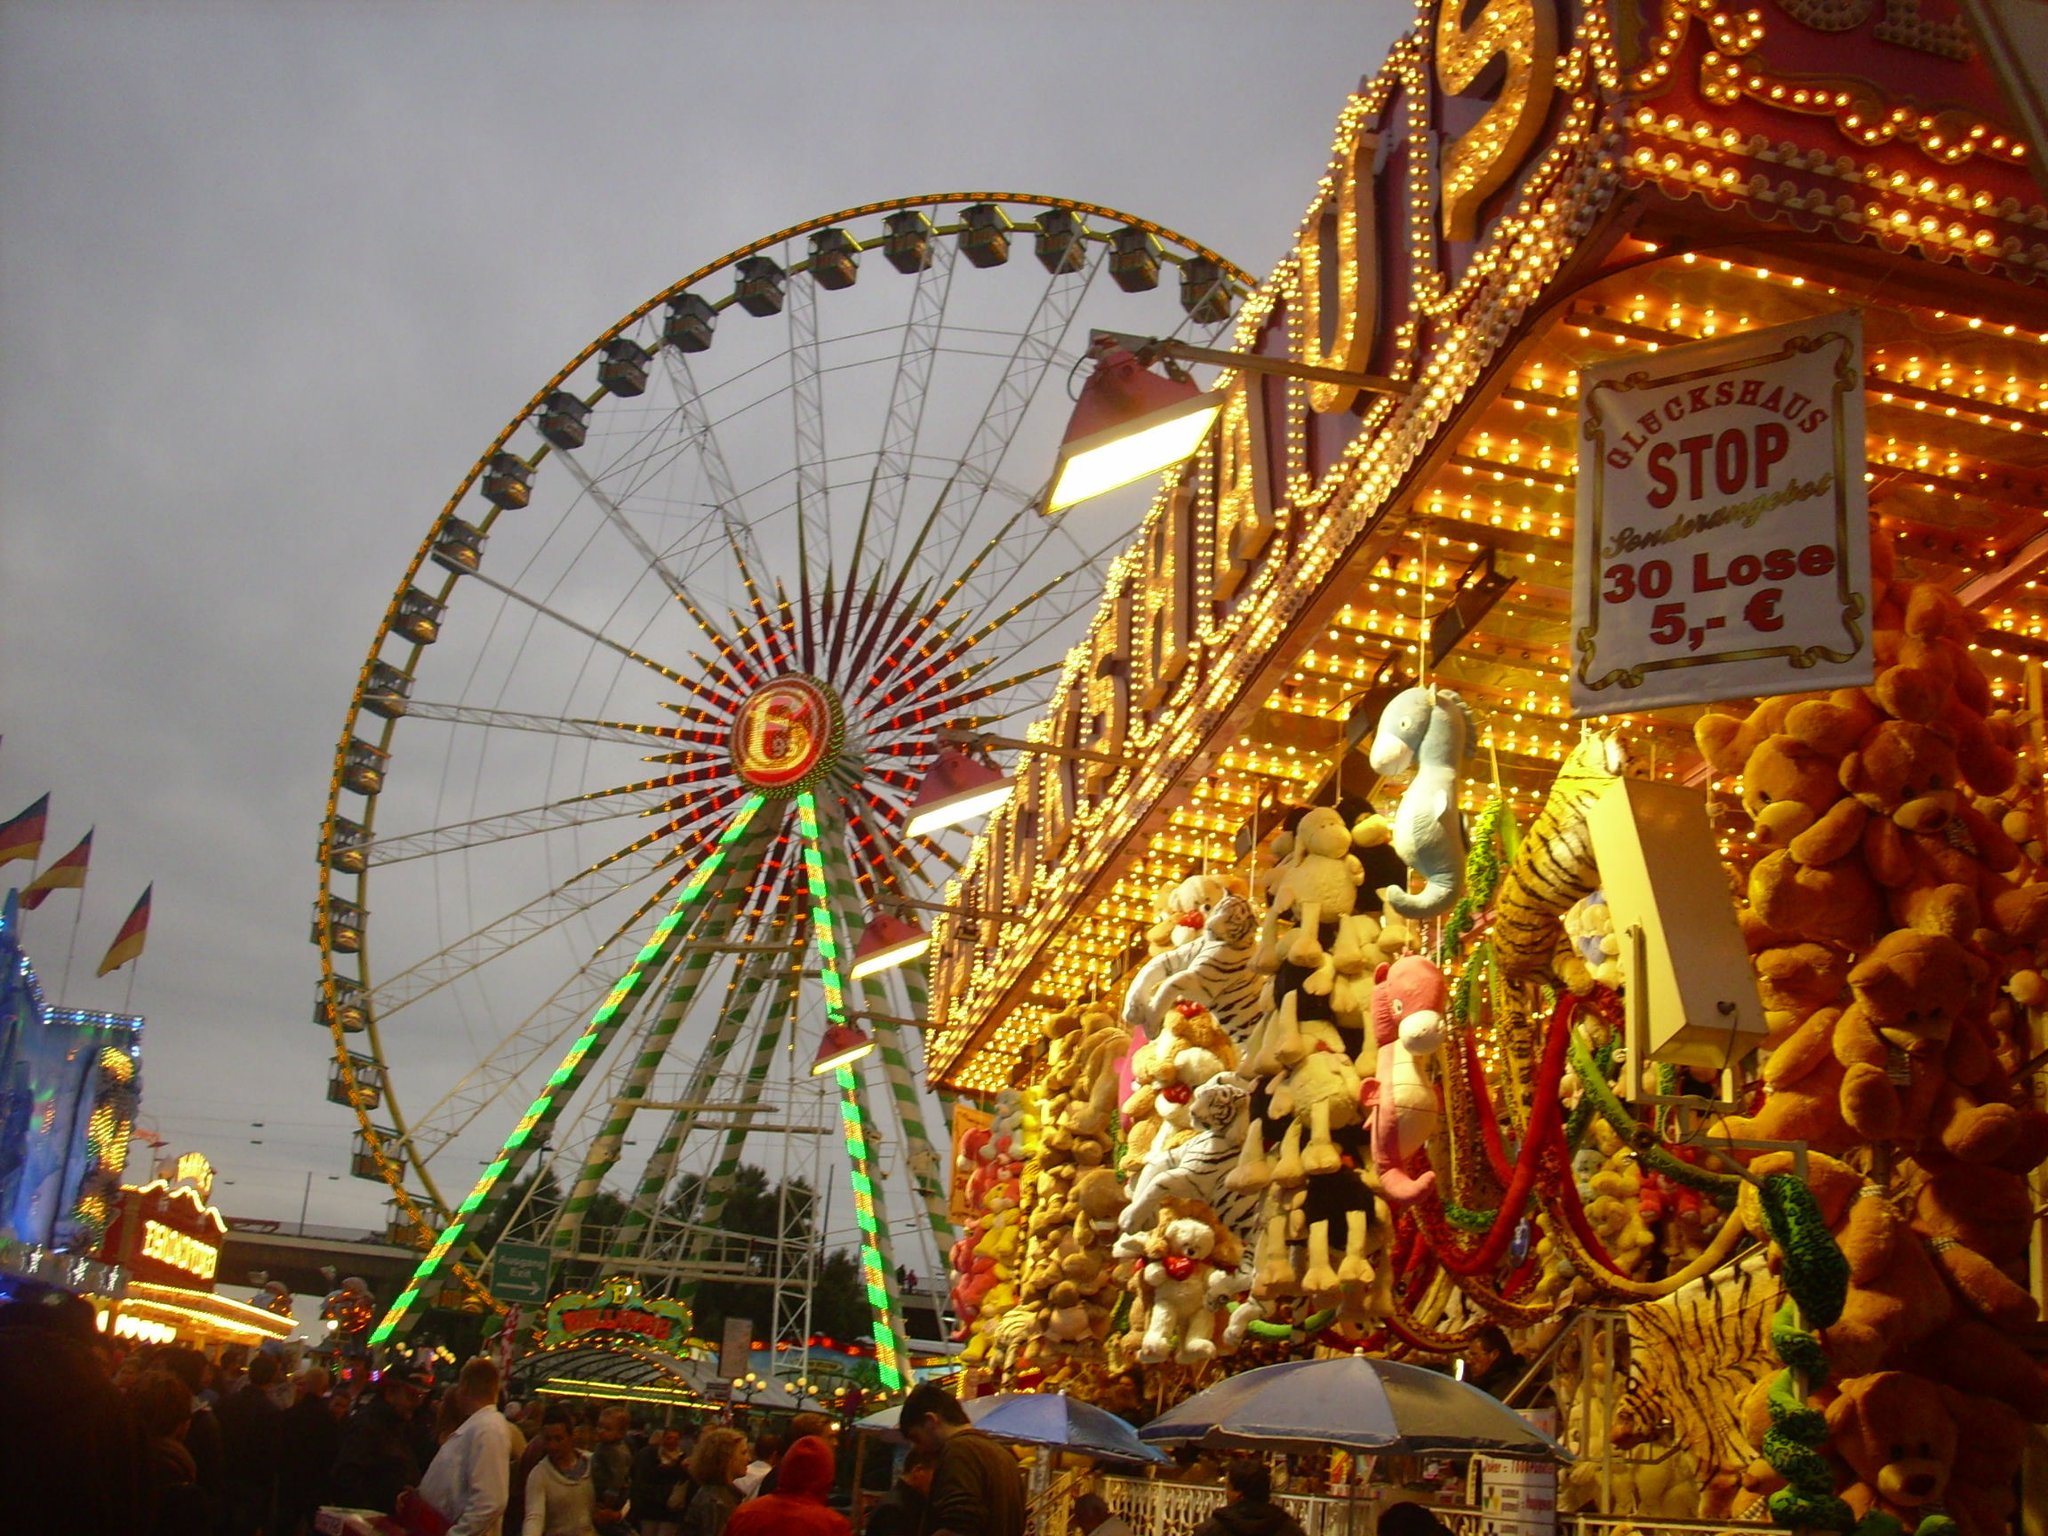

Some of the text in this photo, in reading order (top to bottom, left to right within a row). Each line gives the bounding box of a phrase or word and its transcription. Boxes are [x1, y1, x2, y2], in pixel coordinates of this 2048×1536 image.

[1647, 421, 1790, 509] STOP
[1602, 472, 1835, 559] Sonderangebot
[1603, 559, 1673, 604] 30
[1650, 588, 1784, 651] 5,- €
